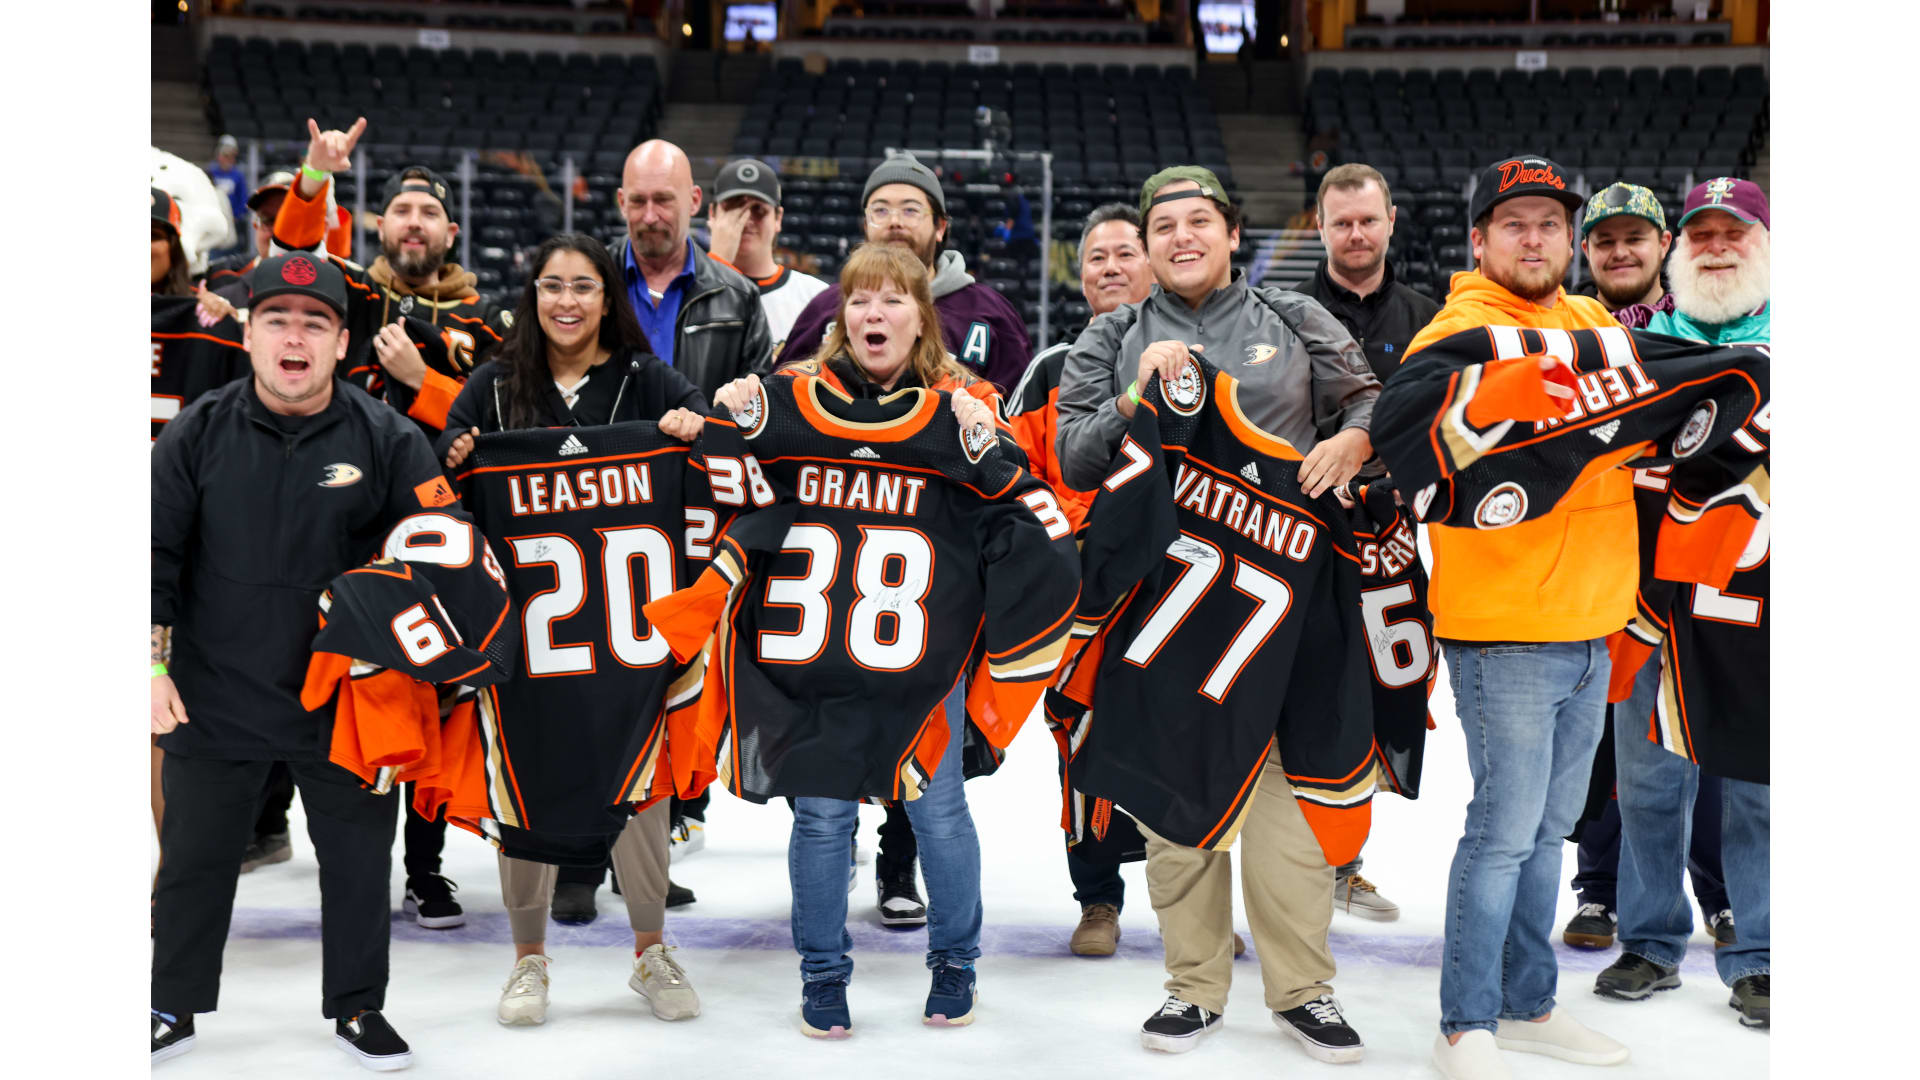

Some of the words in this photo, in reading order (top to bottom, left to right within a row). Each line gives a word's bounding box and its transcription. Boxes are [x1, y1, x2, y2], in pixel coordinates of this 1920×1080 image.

[1498, 160, 1566, 192] Ducks
[960, 321, 990, 367] A
[508, 462, 653, 517] LEASON
[703, 454, 776, 507] 38
[797, 464, 926, 517] GRANT
[1172, 461, 1318, 563] VATRANO
[505, 523, 677, 679] 20
[757, 522, 936, 673] 38
[1122, 529, 1294, 705] 77
